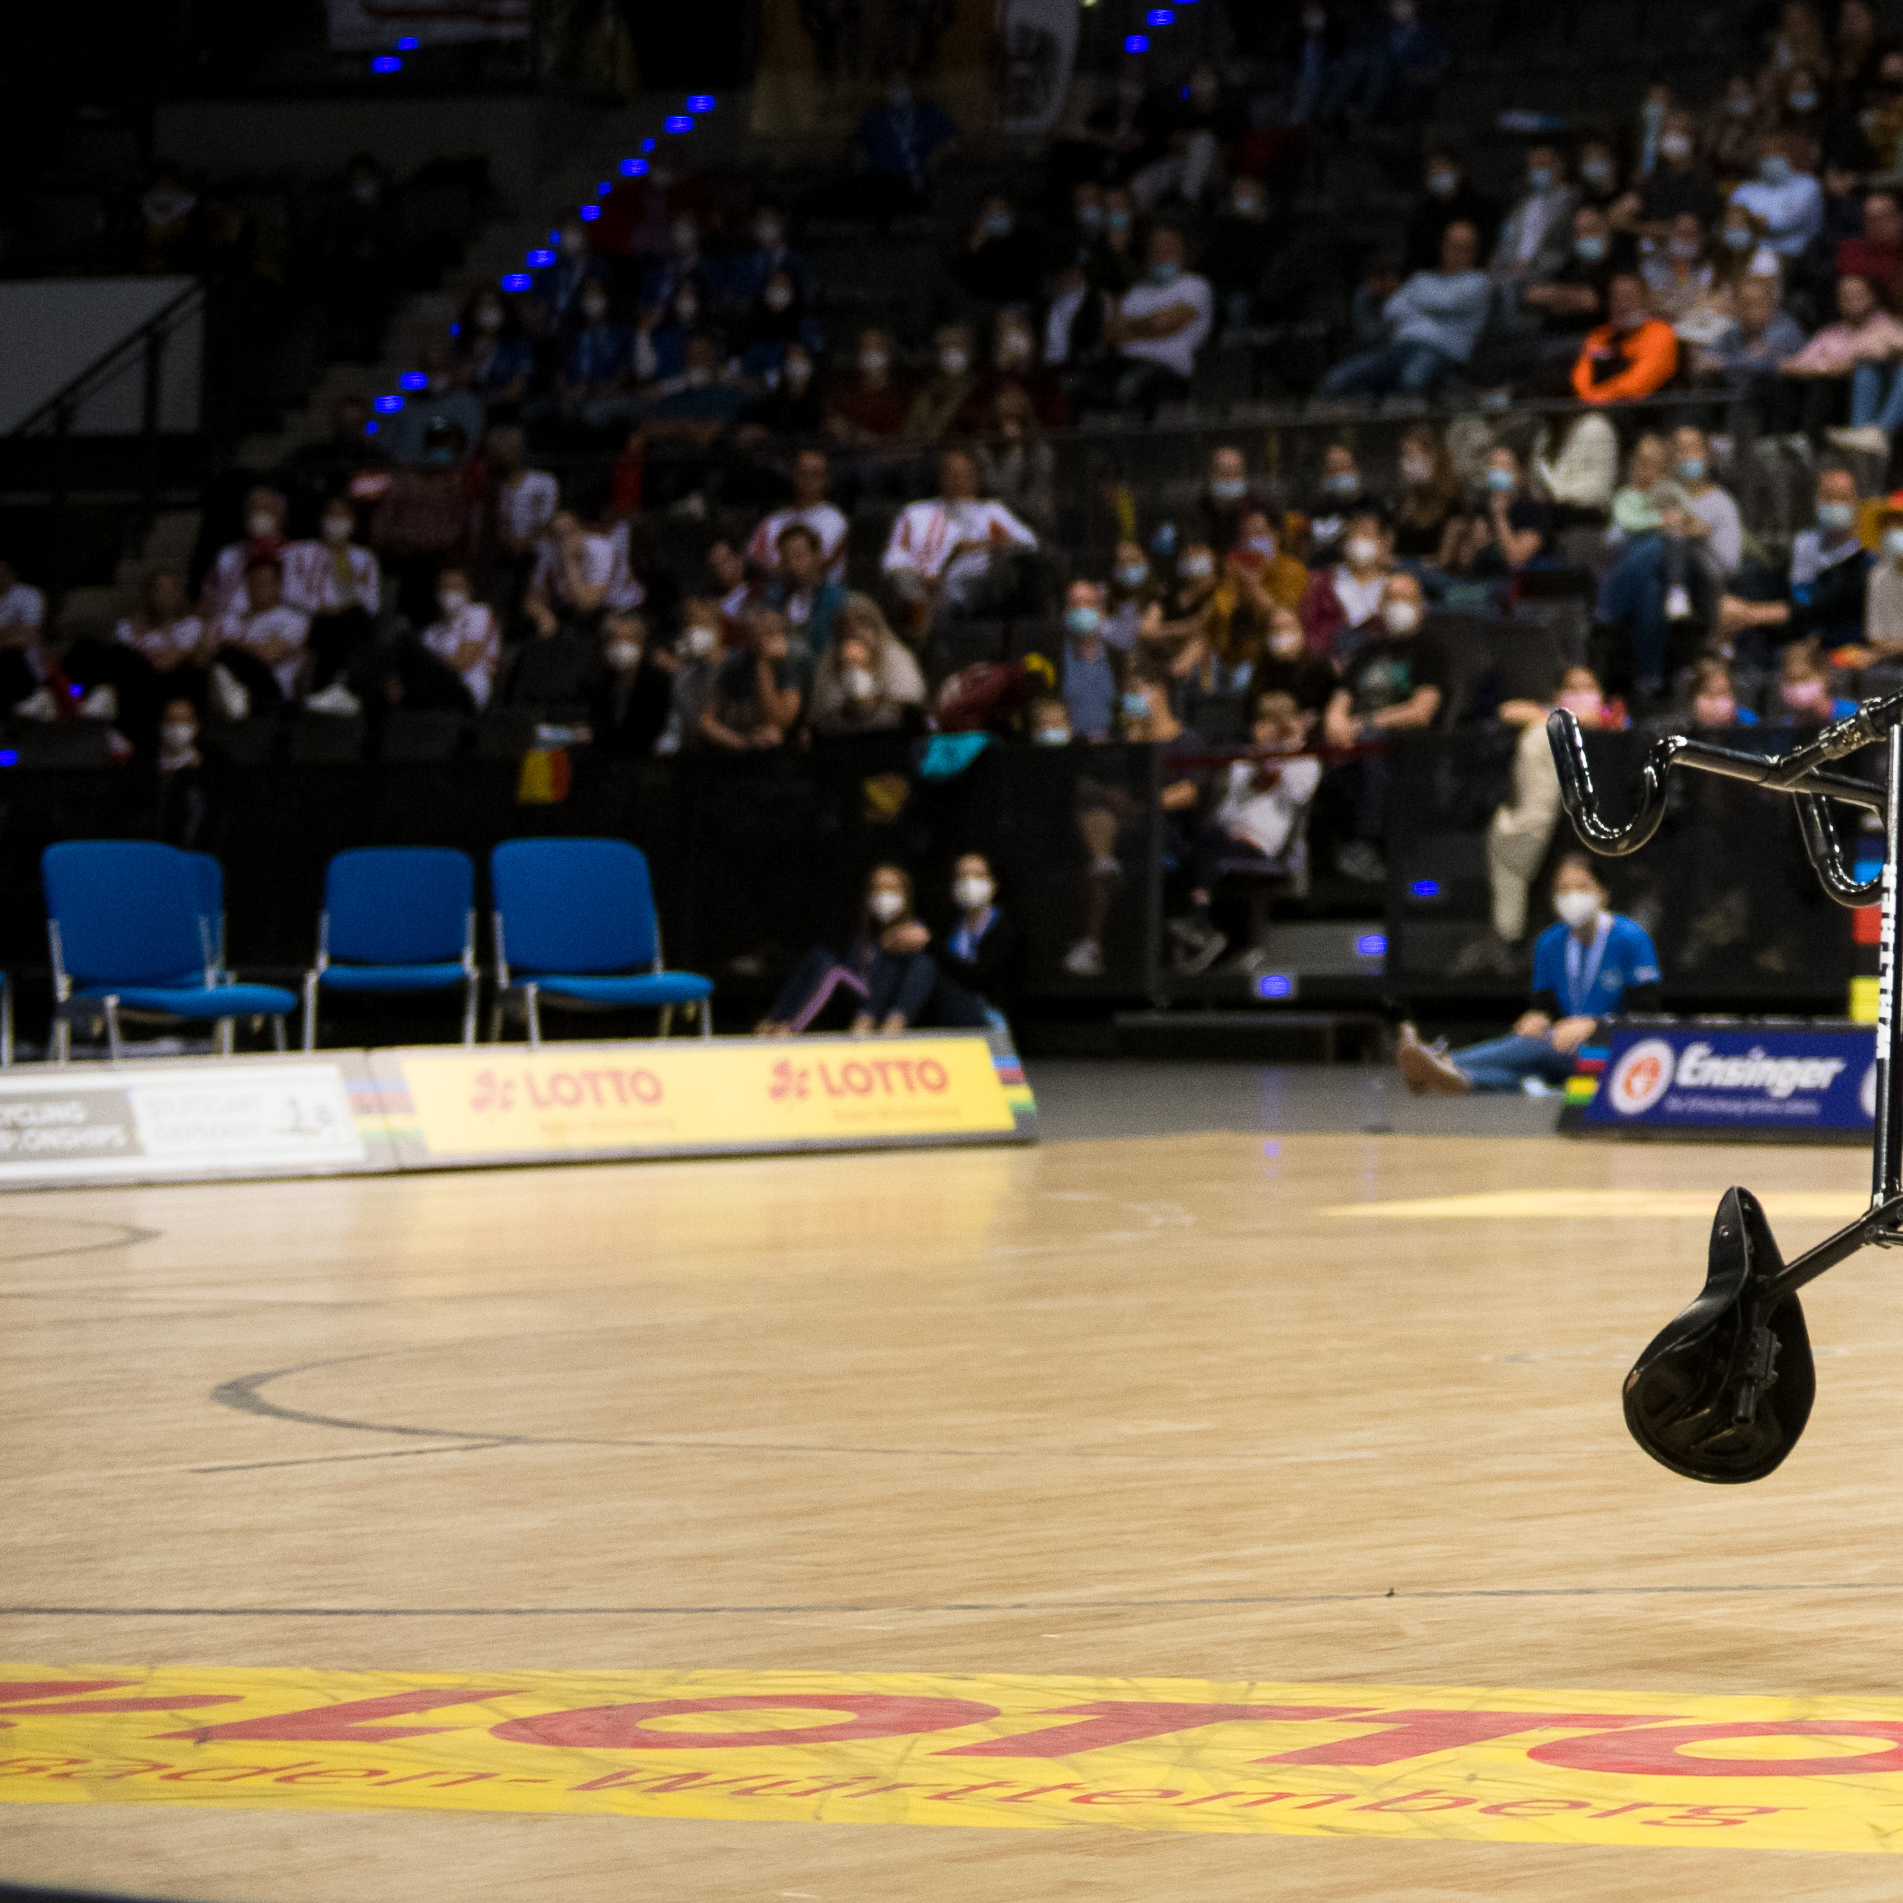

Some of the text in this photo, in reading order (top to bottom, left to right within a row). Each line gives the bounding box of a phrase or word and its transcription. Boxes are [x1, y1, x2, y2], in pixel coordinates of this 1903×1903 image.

[523, 1066, 665, 1109] LOTTO
[818, 1057, 951, 1098] LOTTO
[1674, 1041, 1848, 1099] Ensinger
